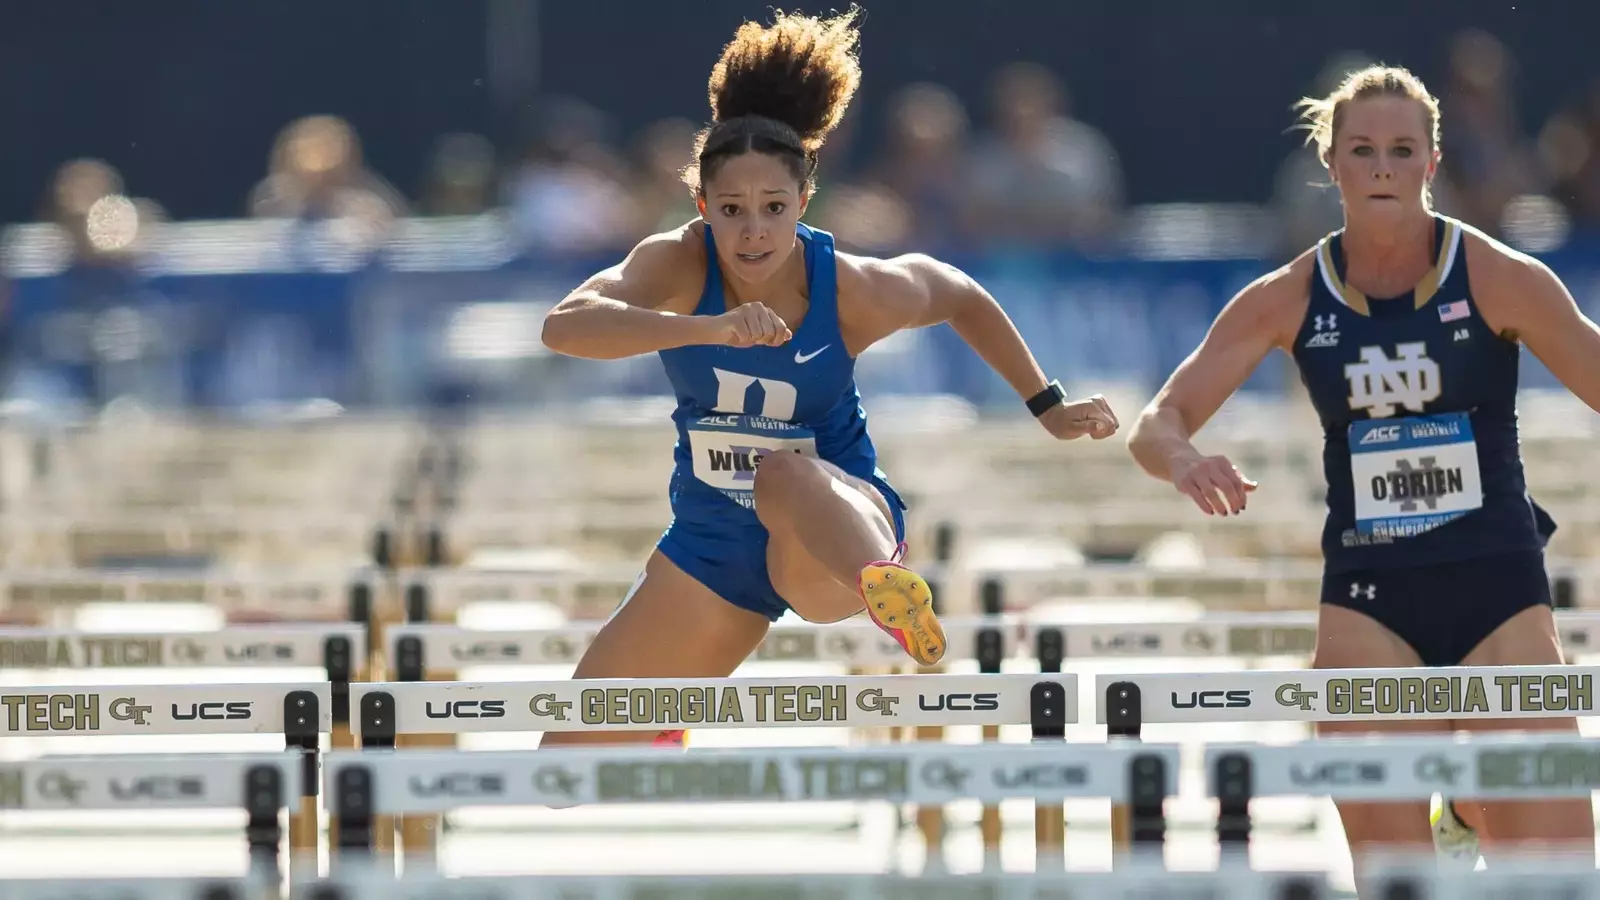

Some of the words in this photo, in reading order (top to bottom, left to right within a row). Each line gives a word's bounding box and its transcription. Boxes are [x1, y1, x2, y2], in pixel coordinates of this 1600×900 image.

[1305, 331, 1340, 347] ACC
[1453, 328, 1469, 341] AB
[1359, 425, 1401, 445] ACC
[1371, 467, 1463, 501] O'BRIEN
[426, 700, 506, 718] UCS
[529, 693, 572, 721] GT
[581, 687, 744, 724] GEORGIA
[749, 685, 847, 722] TECH
[856, 688, 900, 716] GT
[919, 693, 1000, 711] UCS
[1171, 690, 1252, 708] UCS
[1274, 683, 1318, 711] GT
[1326, 676, 1489, 714] GEORGIA
[1495, 674, 1593, 711] TECH
[1, 694, 100, 731] TECH
[109, 697, 152, 726] GT
[171, 702, 252, 720] UCS
